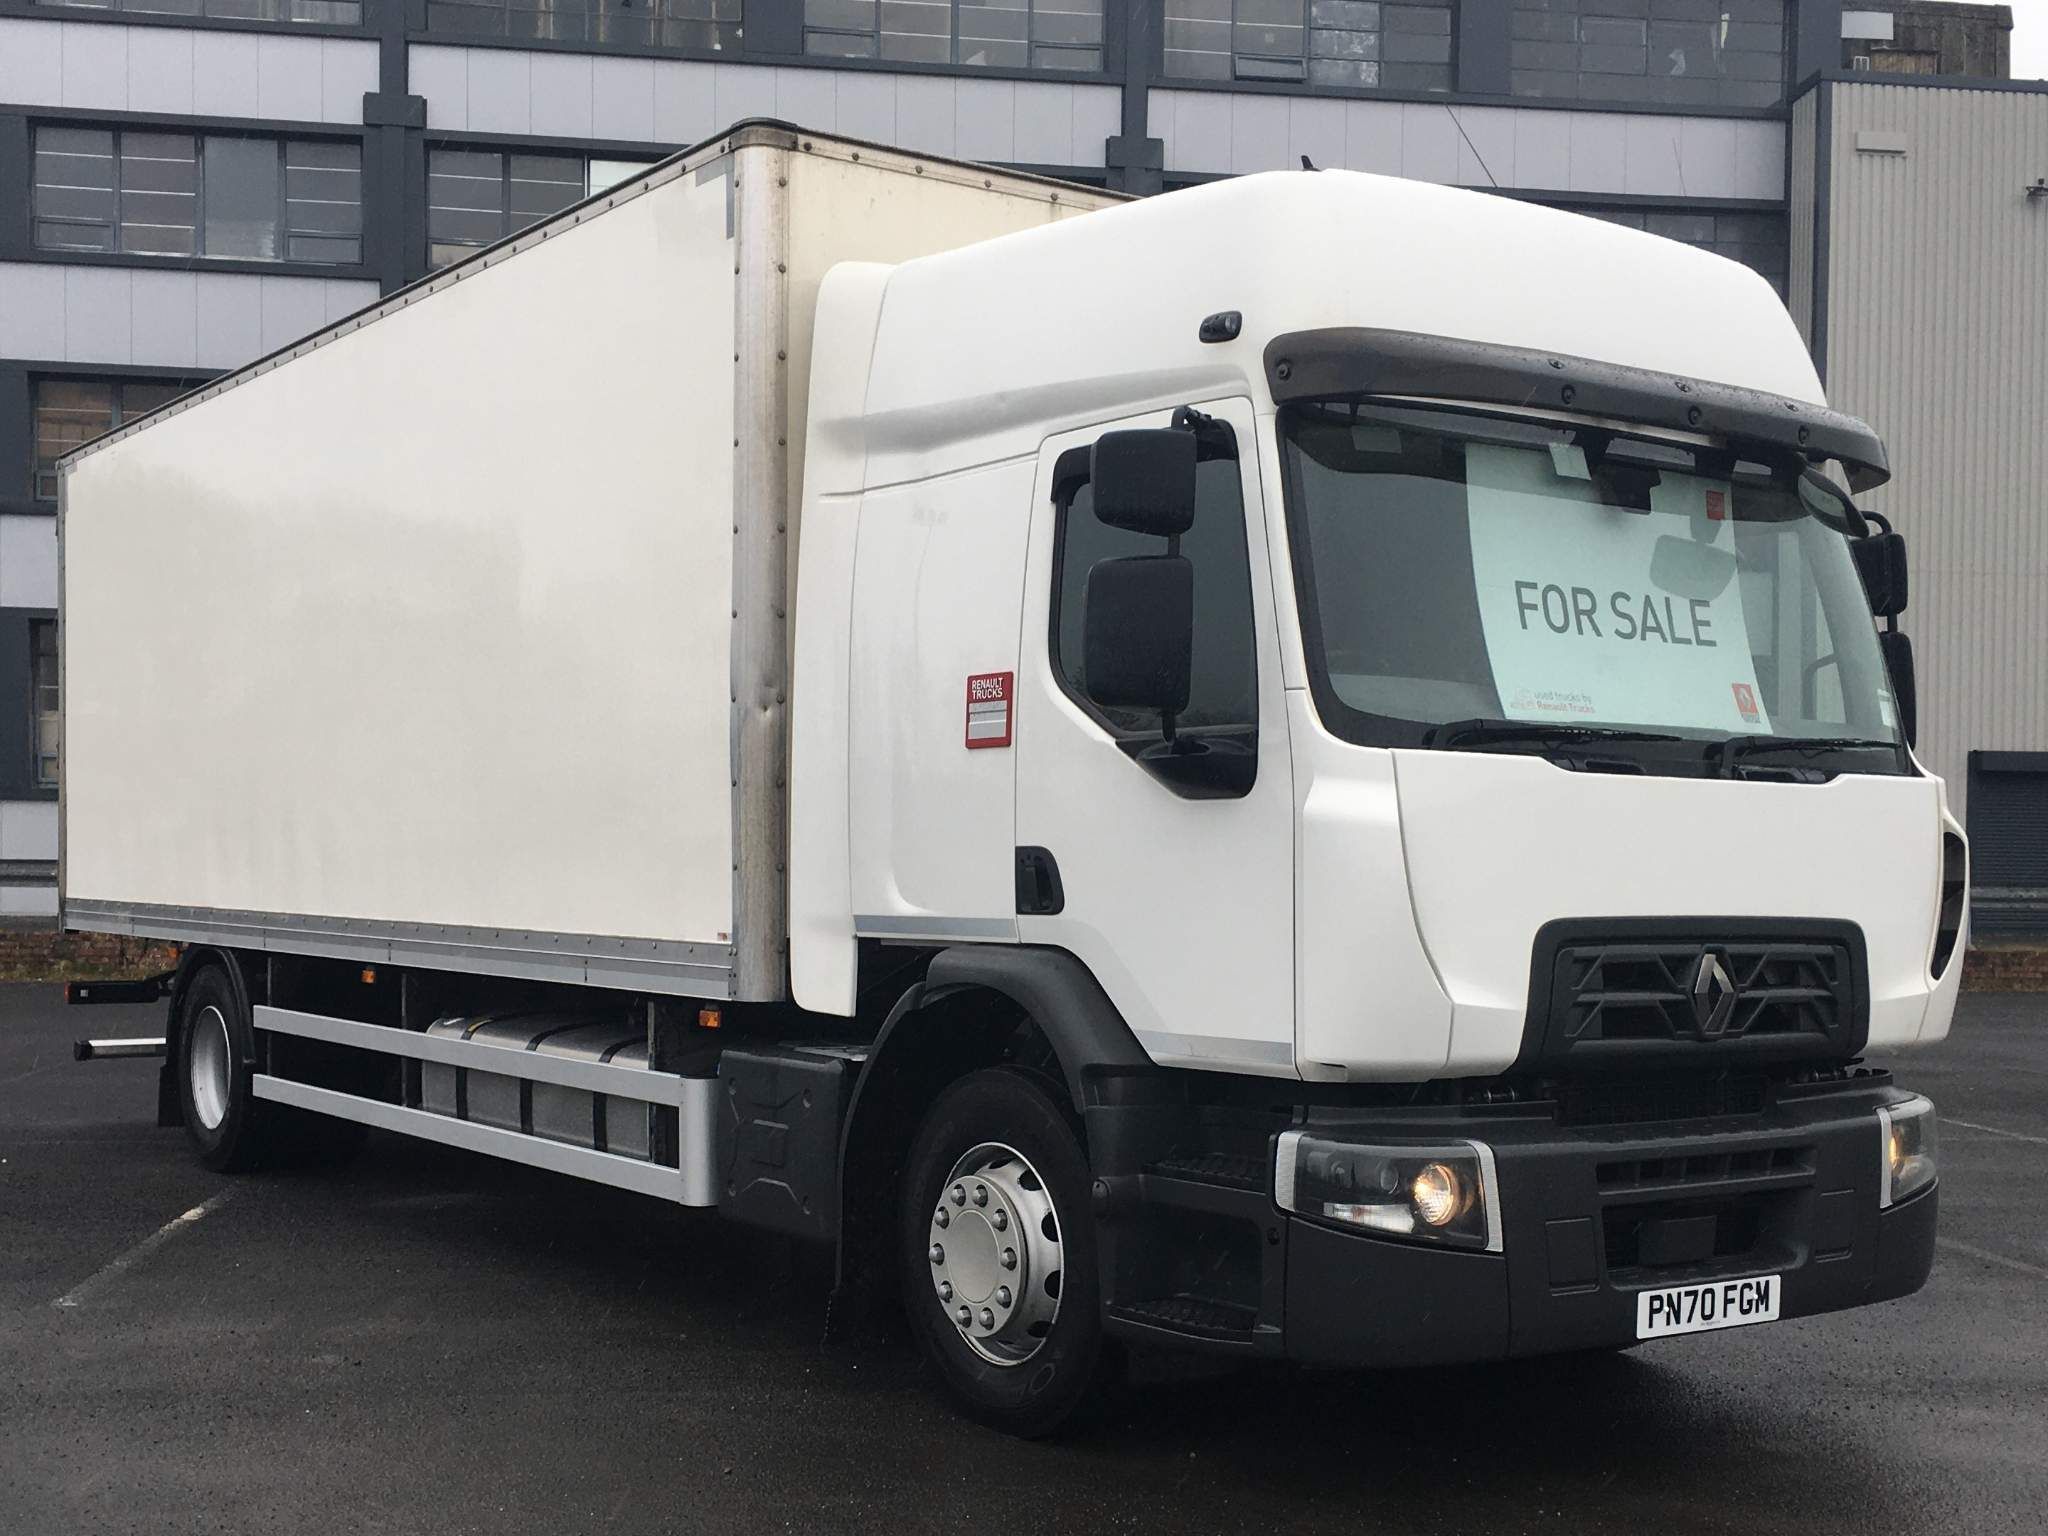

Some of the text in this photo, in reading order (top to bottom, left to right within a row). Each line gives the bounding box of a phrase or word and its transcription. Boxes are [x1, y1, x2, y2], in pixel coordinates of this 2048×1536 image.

[1514, 580, 1717, 647] FOR SALE
[972, 677, 1003, 690] RENAULT
[972, 688, 1003, 700] TRUCKS
[1534, 690, 1554, 700] used
[1555, 691, 1581, 702] trucks
[1568, 702, 1596, 714] Trucks
[1648, 1280, 1770, 1329] PN70 FGM
